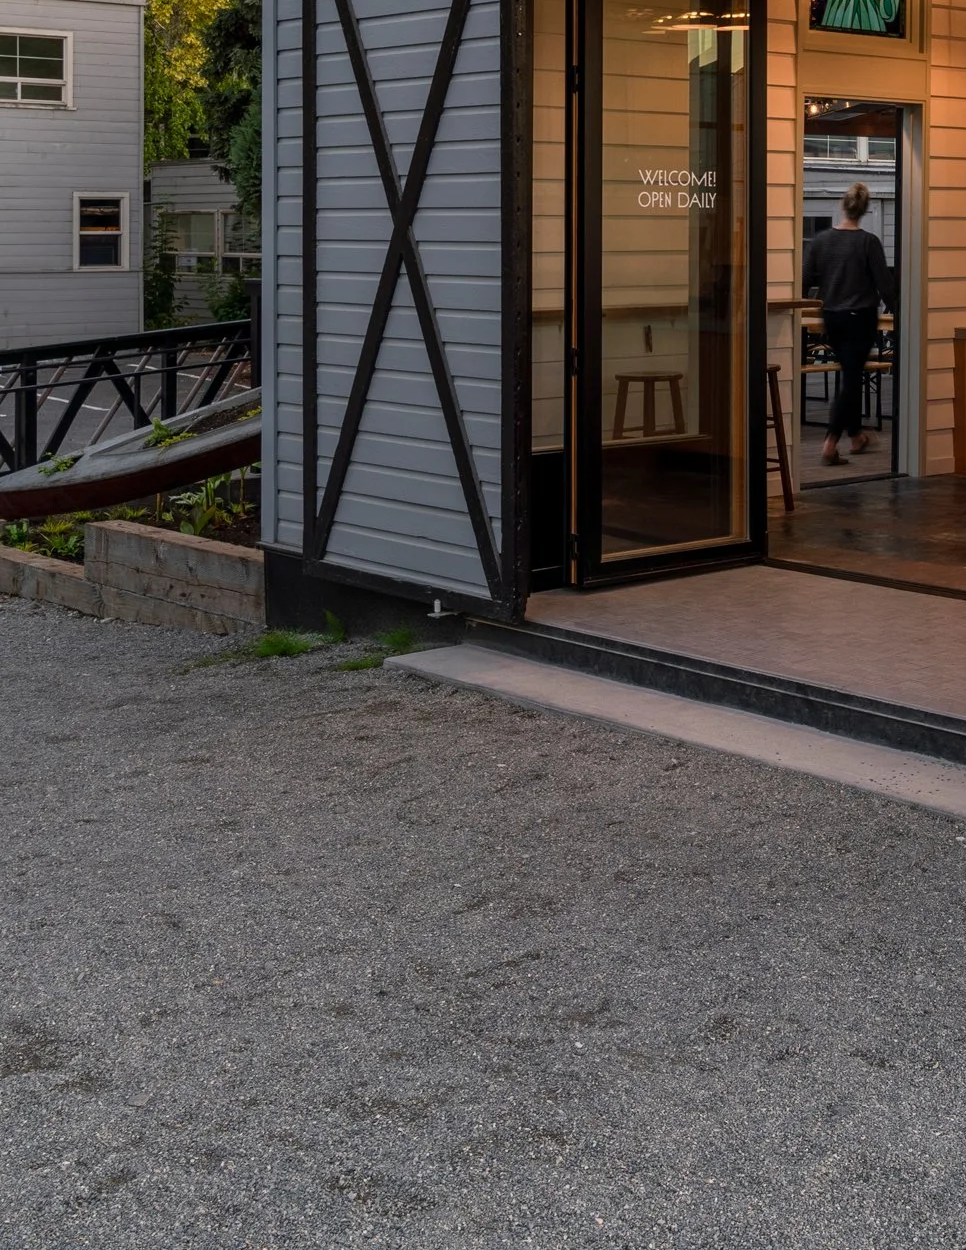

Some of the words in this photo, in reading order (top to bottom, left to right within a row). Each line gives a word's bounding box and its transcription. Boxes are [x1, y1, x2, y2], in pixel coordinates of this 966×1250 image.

[638, 169, 717, 187] WELCOME!
[638, 191, 672, 208] OPEN
[677, 192, 717, 208] DAILY
